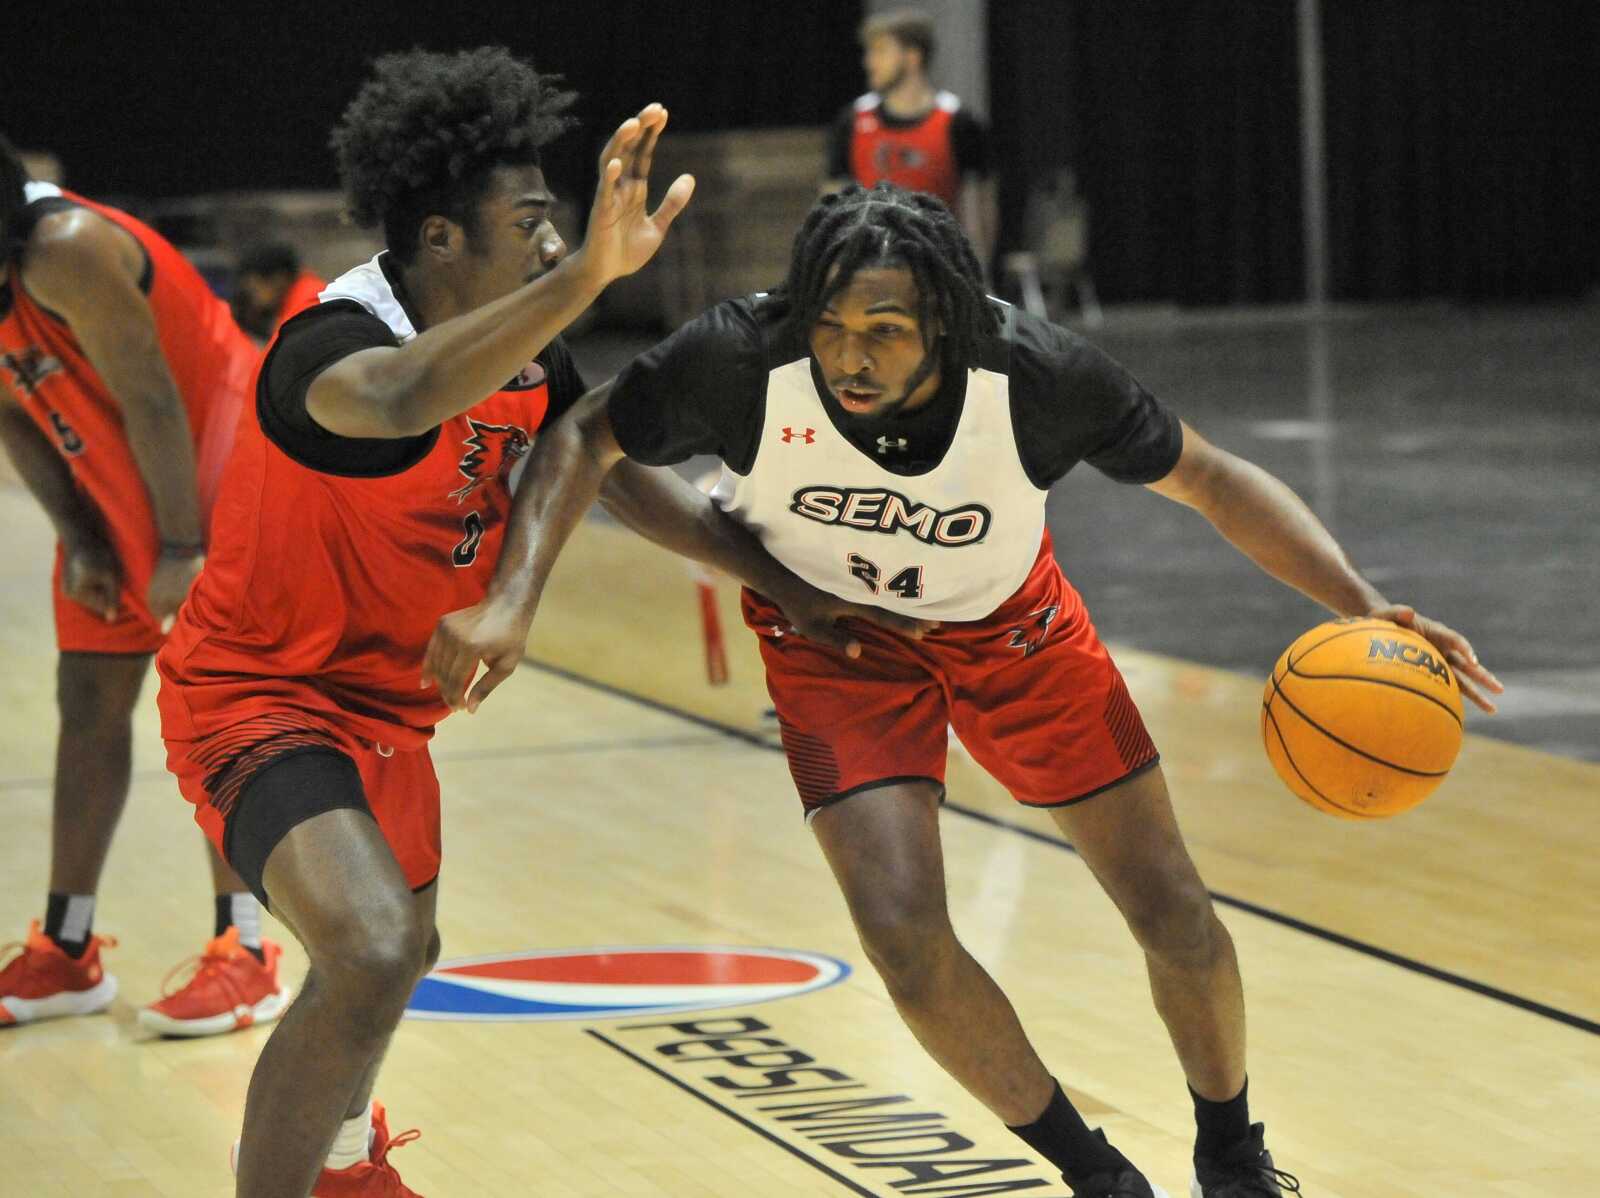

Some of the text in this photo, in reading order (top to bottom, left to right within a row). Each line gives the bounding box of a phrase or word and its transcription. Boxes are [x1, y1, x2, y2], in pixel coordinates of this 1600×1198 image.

[452, 511, 484, 567] 0
[790, 486, 991, 547] SEMO
[847, 552, 924, 599] 24
[1368, 638, 1451, 687] NCAA
[616, 1016, 867, 1098] PEPSI
